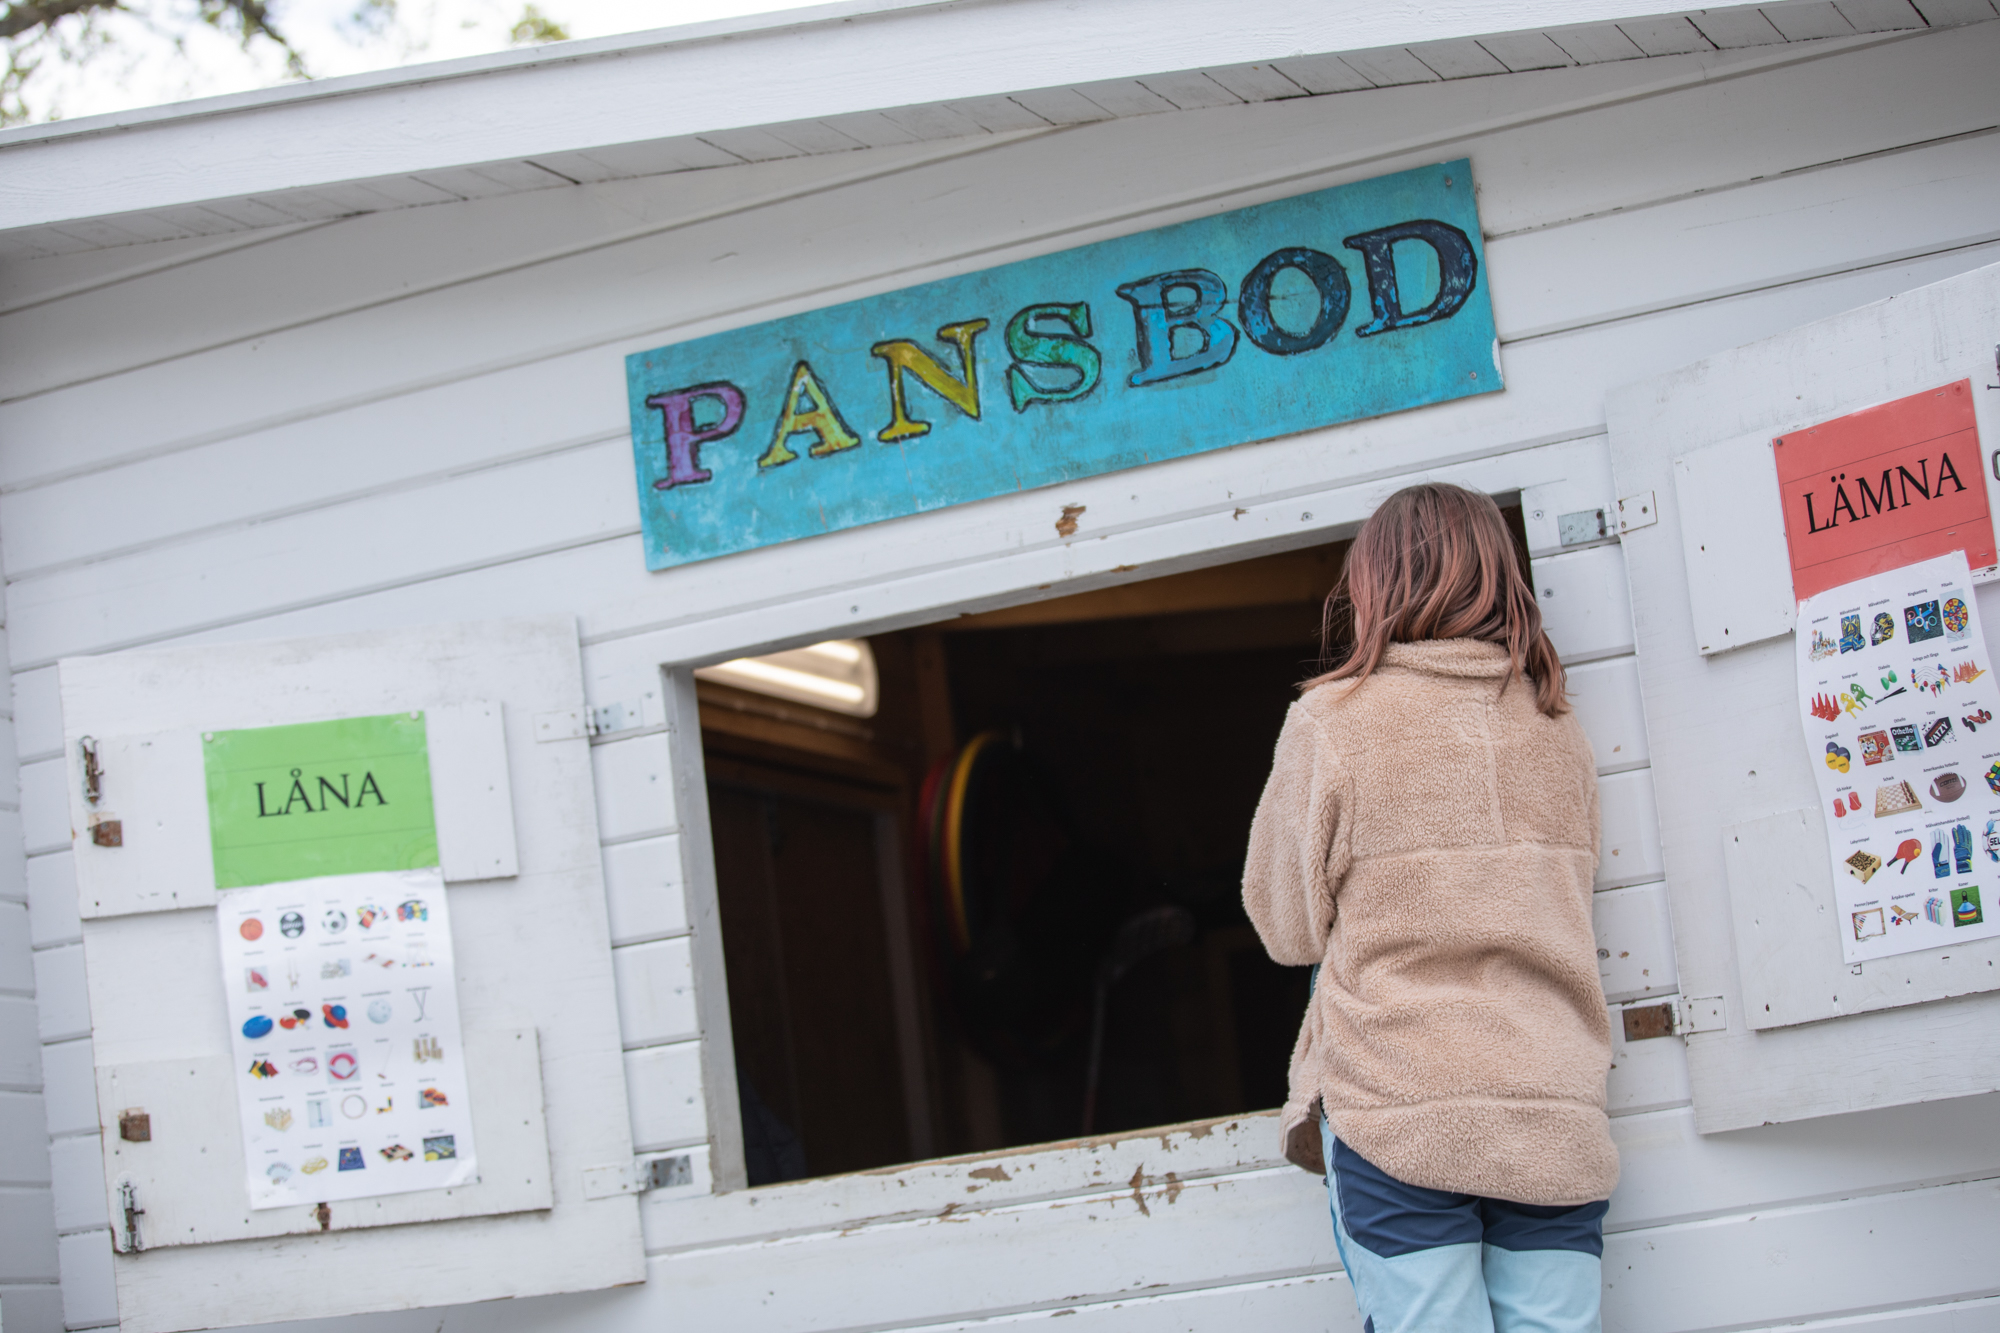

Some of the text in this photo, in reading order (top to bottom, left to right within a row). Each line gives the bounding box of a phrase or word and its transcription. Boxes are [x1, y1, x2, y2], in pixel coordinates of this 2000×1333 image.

[645, 219, 1478, 490] PANSBOD
[1802, 452, 1967, 535] LÄMNA
[1892, 727, 1914, 736] Othello
[1928, 721, 1949, 746] YATZY
[254, 768, 388, 818] LÅNA
